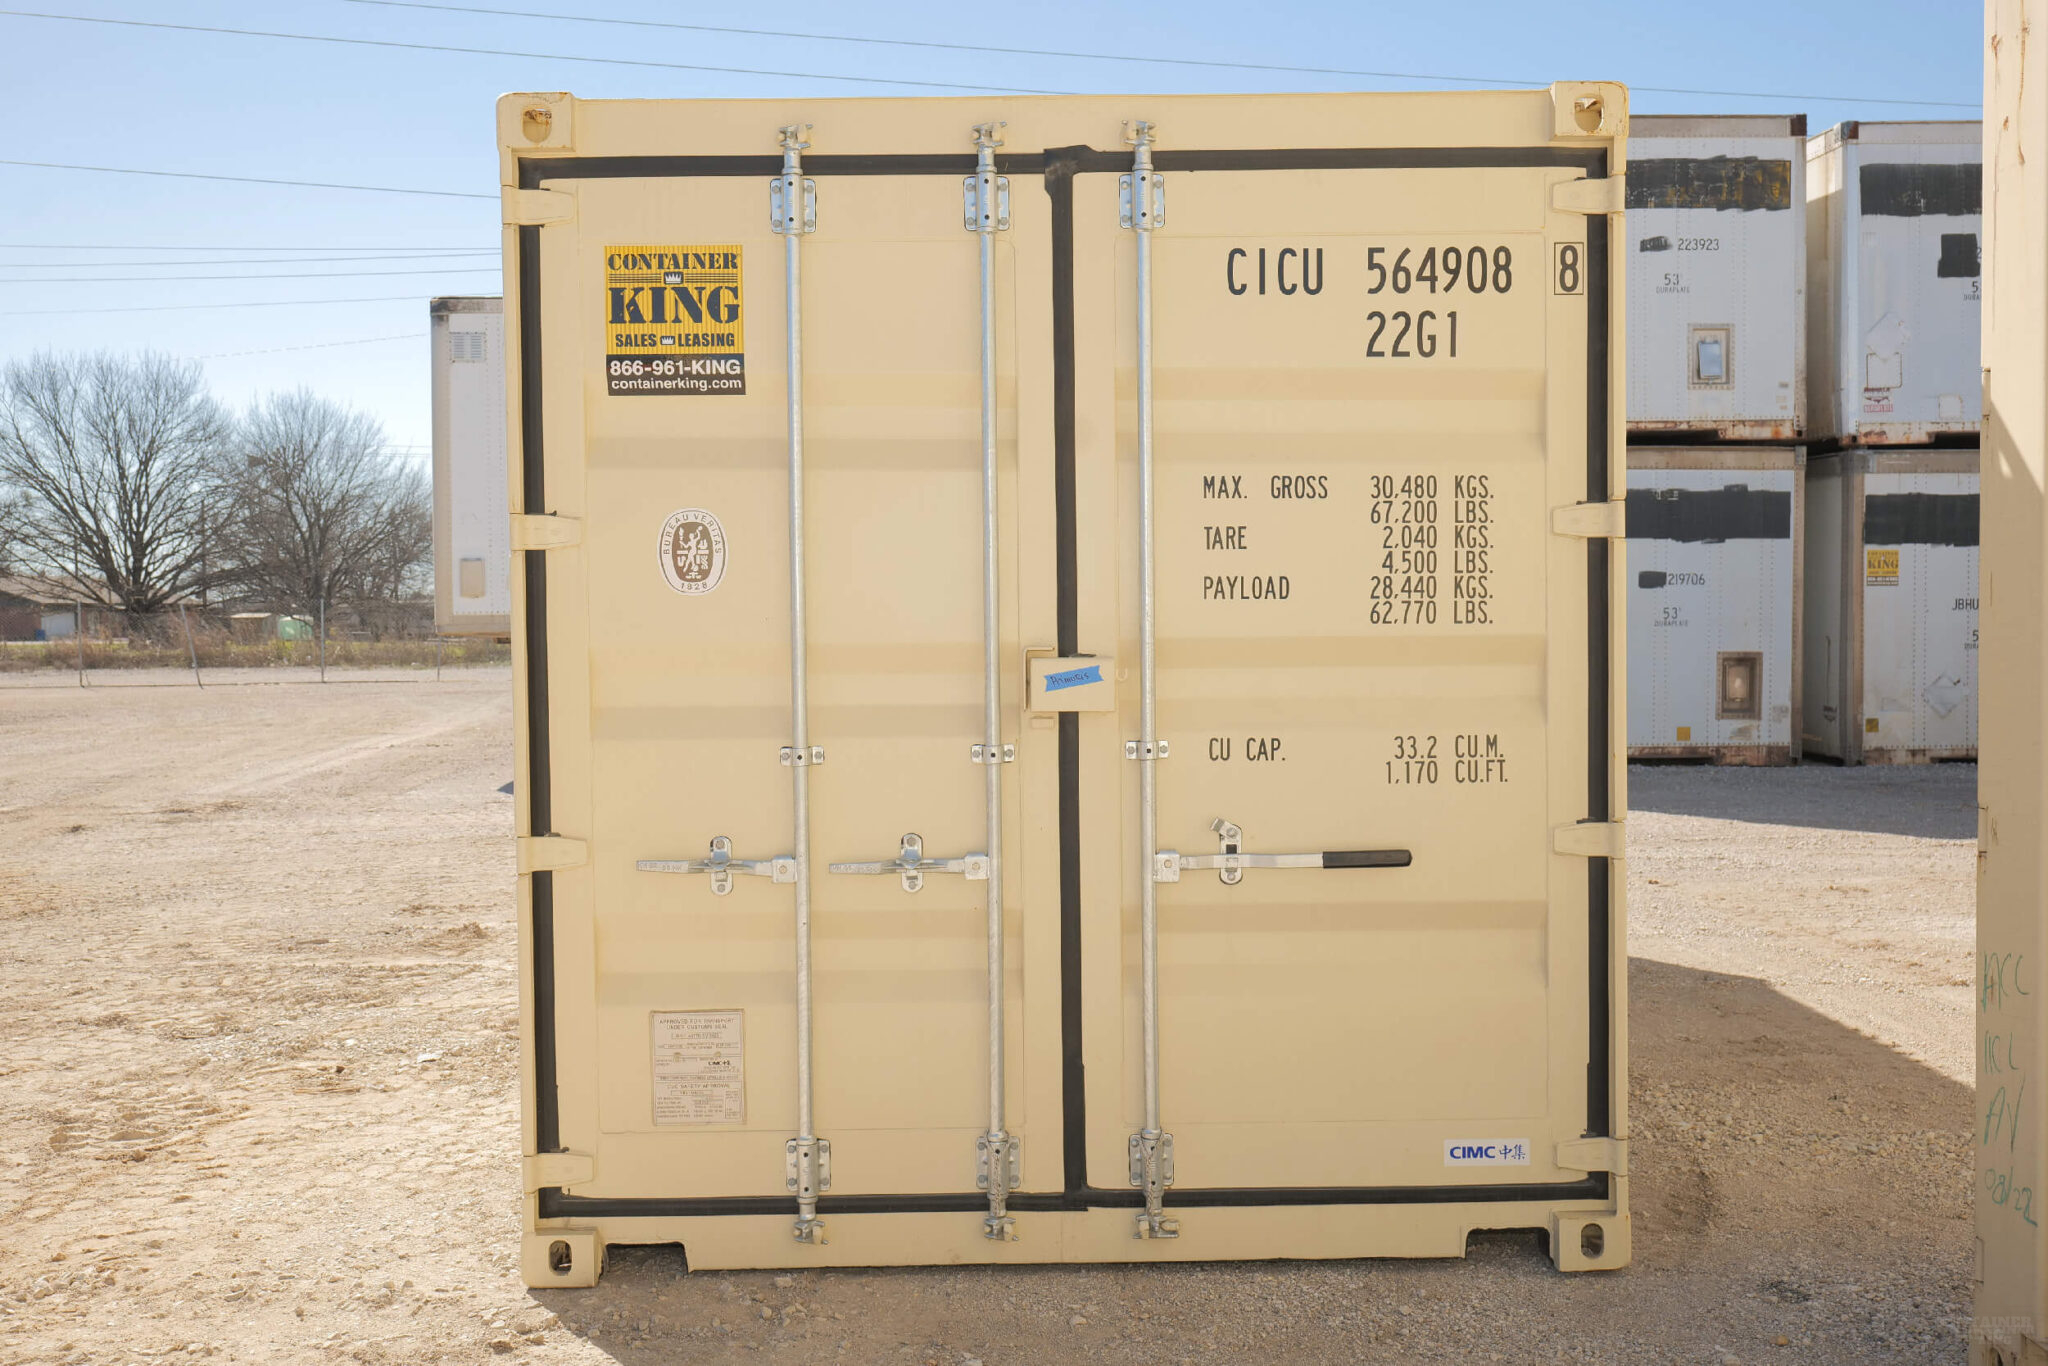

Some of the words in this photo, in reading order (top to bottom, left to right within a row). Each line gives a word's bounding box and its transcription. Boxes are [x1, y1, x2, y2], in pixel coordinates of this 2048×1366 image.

[1677, 238, 1720, 251] 223923
[607, 252, 739, 271] CONTAINER
[1226, 247, 1324, 296] CICU
[1366, 245, 1513, 295] 564908
[1559, 244, 1580, 293] 8
[1972, 281, 1980, 293] 5
[608, 285, 740, 324] KING
[615, 333, 658, 348] SALES
[677, 332, 735, 348] LEASING
[1365, 309, 1458, 358] 22G1
[609, 359, 741, 376] 866-961-KING
[611, 376, 742, 391] containerking.com
[1202, 475, 1248, 499] MAX.
[1270, 475, 1329, 499] GROSS
[1369, 474, 1438, 500] 30,480
[1453, 474, 1495, 499] KGS.
[1369, 500, 1438, 524] 67,200
[1453, 500, 1494, 524] LBS.
[663, 513, 689, 555] BUREAU
[693, 513, 722, 554] VERITAS
[1203, 526, 1248, 550] TARE
[1382, 525, 1438, 549] 2,040
[1453, 524, 1494, 549] KGS.
[1381, 550, 1438, 574] 4,500
[1453, 550, 1494, 574] LBS.
[1203, 576, 1290, 600] PAYLOAD
[1369, 575, 1438, 600] 28,440
[1453, 575, 1494, 599] KGS.
[1668, 573, 1706, 586] 219706
[1369, 600, 1437, 625] 62,770
[1453, 600, 1494, 624] LBS.
[1952, 598, 1979, 610] JBHU
[1208, 738, 1231, 761] CU
[1246, 737, 1286, 761] CAP.
[1393, 736, 1438, 760] 33.2
[1454, 734, 1504, 758] CU.M.
[1385, 760, 1438, 784] 1,170
[1454, 759, 1509, 783] CU.FT.
[1449, 1145, 1496, 1159] CIMC
[1499, 1144, 1526, 1160] 中集
